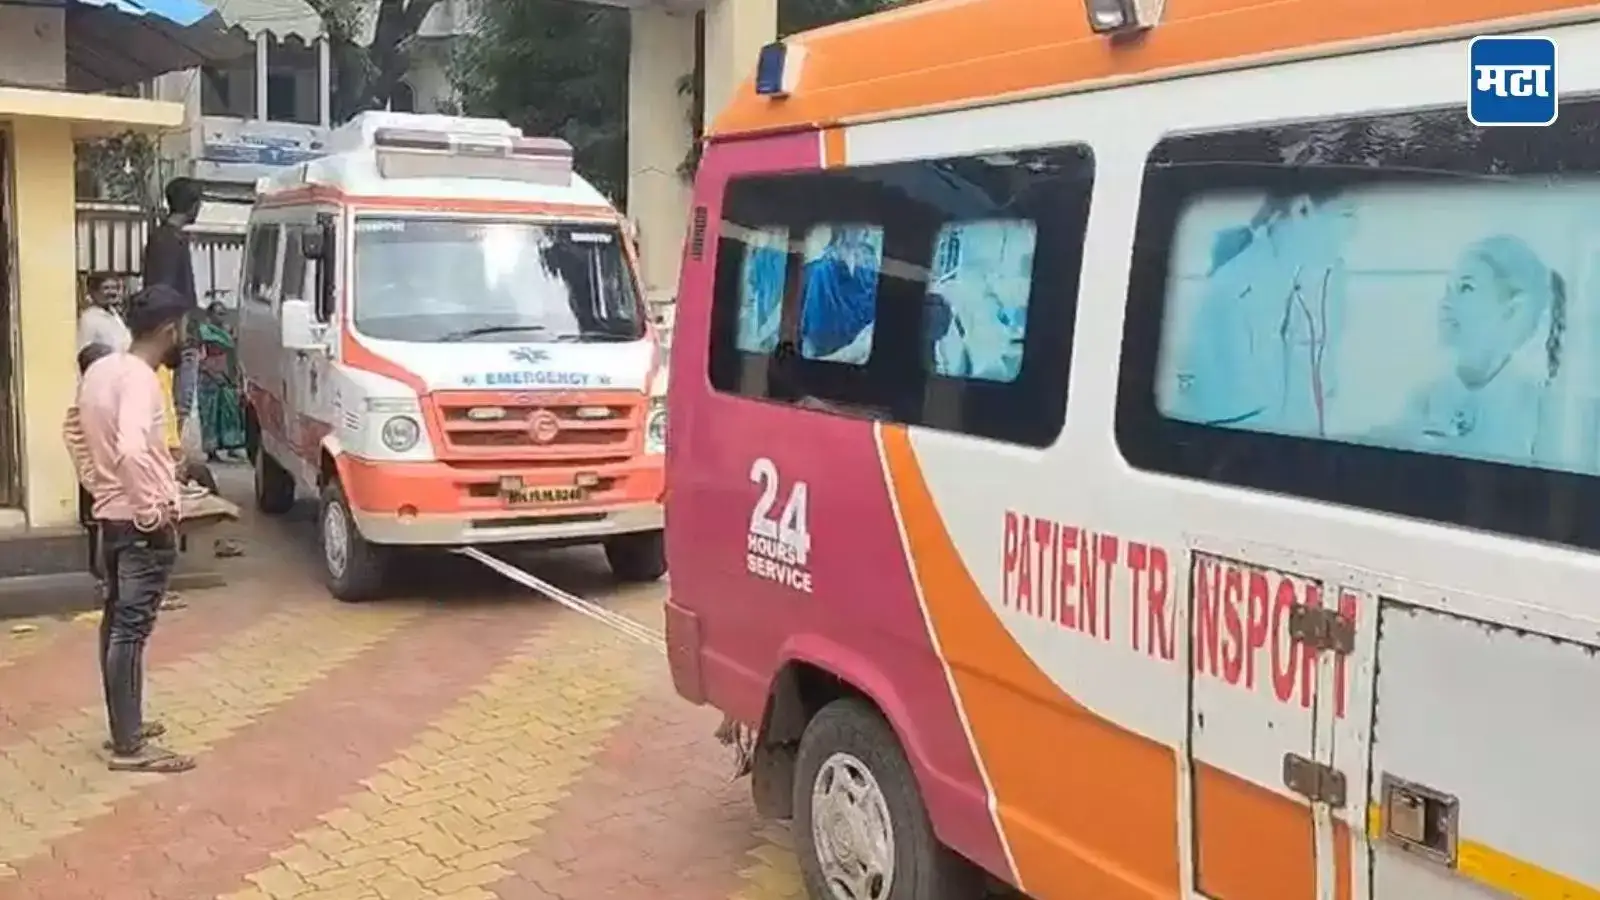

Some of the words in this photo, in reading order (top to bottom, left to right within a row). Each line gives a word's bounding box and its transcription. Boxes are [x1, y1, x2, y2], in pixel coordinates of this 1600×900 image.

[486, 371, 590, 385] EMERGENCY
[750, 457, 811, 565] 24
[748, 533, 797, 564] HOURS
[747, 554, 812, 592] SERVICE
[1003, 510, 1118, 641] PATIENT
[1127, 541, 1357, 719] TRNSPOT
